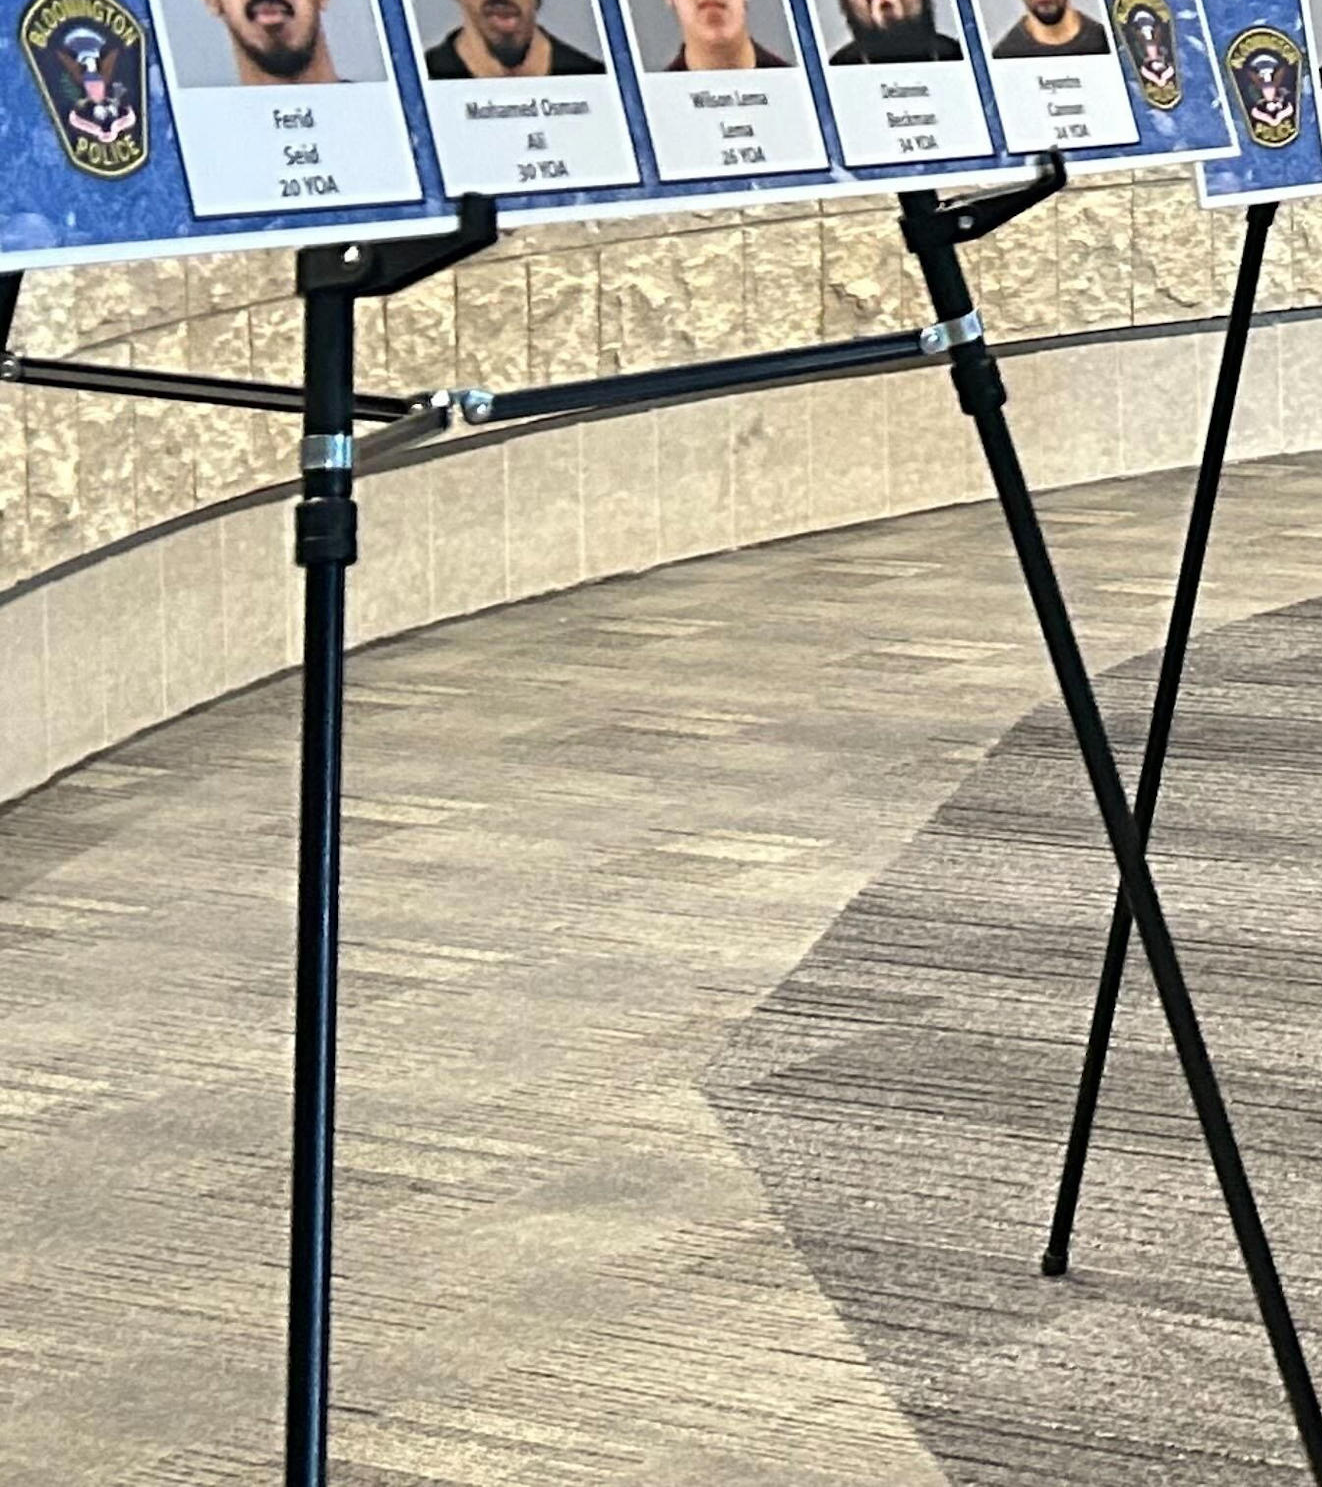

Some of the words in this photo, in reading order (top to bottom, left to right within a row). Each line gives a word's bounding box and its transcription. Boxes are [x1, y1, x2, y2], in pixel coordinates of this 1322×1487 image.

[273, 109, 314, 129] Ferid
[284, 144, 319, 166] Seid
[537, 160, 569, 178] YOA
[279, 179, 301, 197] 20
[303, 175, 340, 195] YOA
